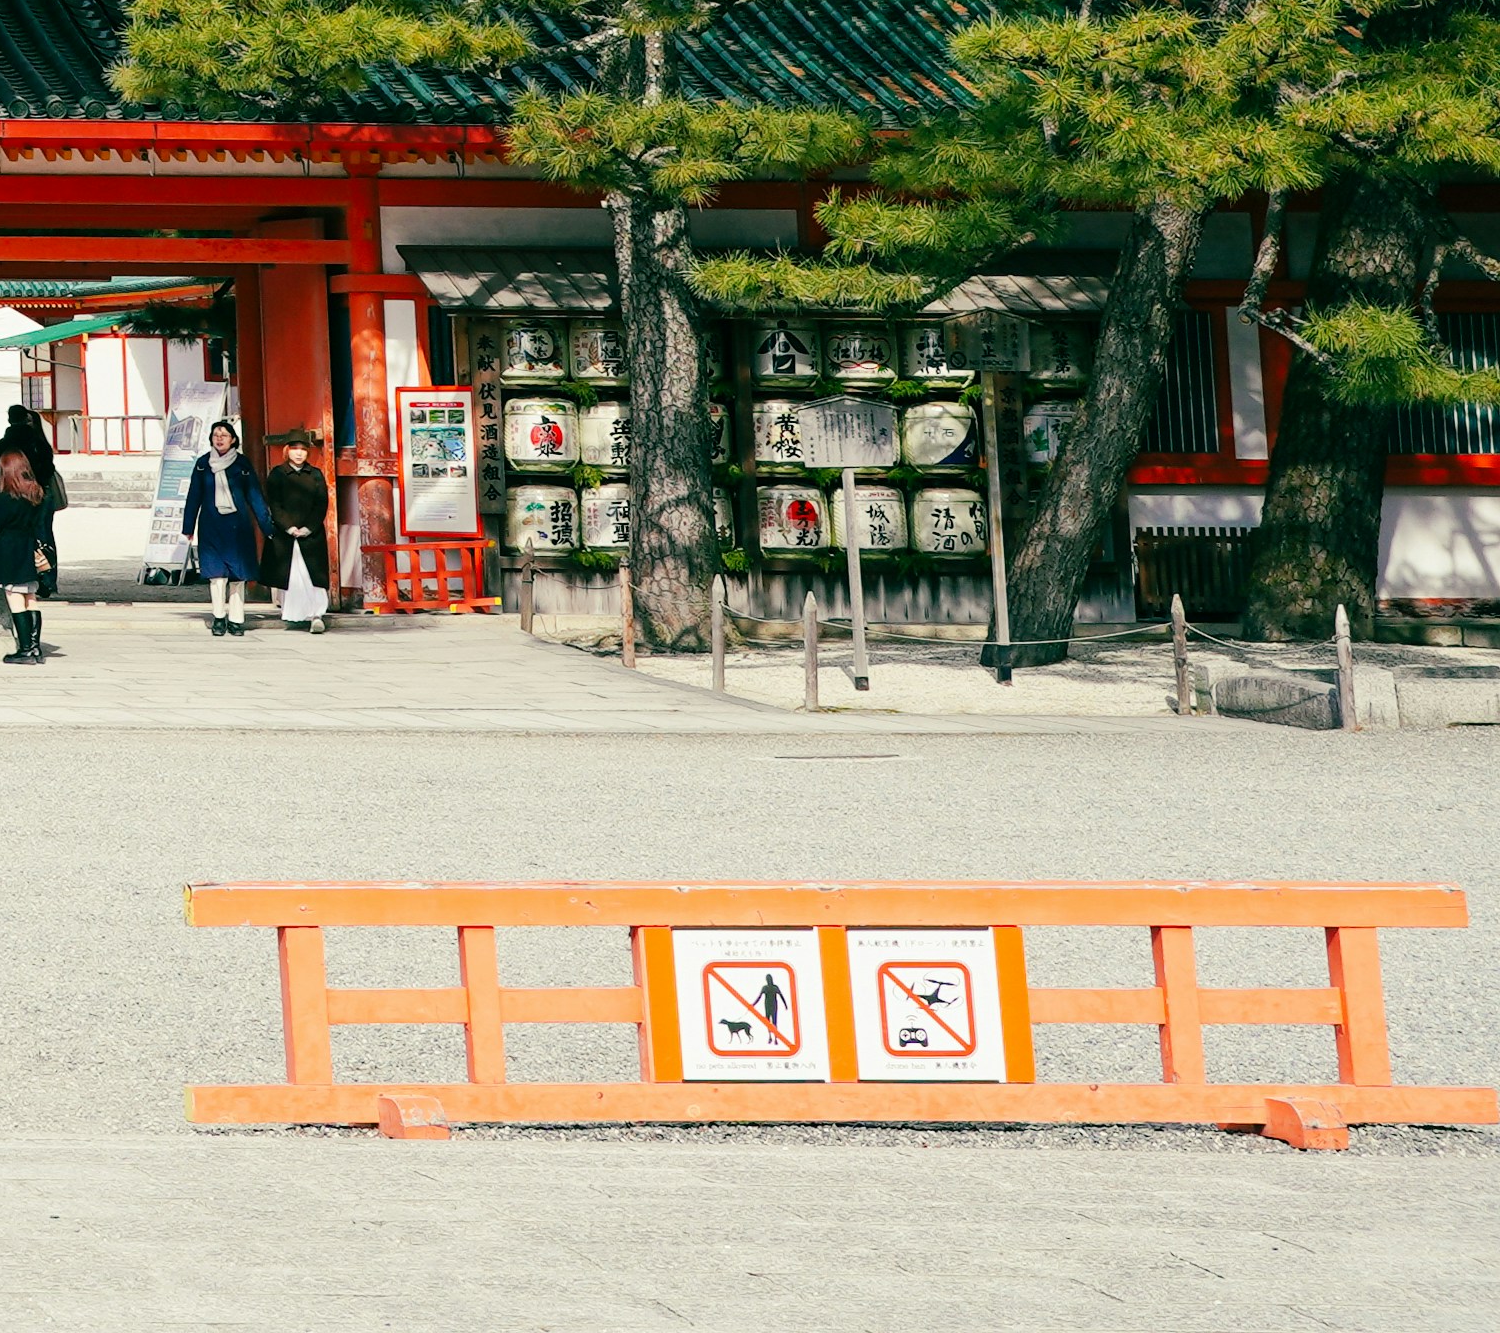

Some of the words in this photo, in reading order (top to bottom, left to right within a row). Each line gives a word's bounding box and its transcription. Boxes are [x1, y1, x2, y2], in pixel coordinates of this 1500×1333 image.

[477, 334, 496, 372] 奉献
[478, 383, 502, 501] 伏見酒造組合
[931, 507, 957, 551] 清酒
